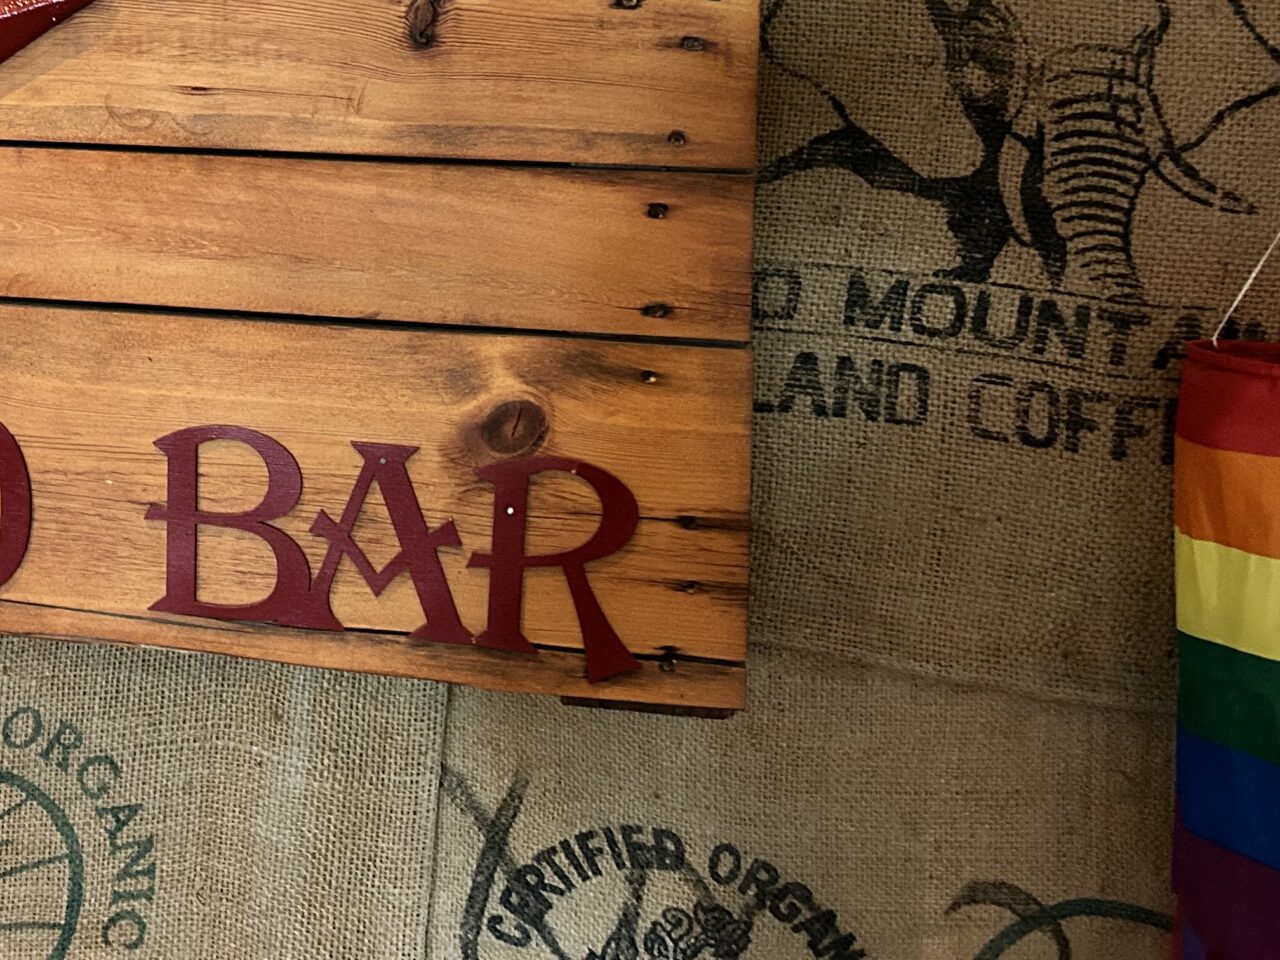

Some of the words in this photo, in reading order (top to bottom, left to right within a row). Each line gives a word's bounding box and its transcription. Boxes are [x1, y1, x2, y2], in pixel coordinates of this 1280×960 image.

[844, 272, 1267, 370] MOUNTA
[145, 424, 641, 684] BAR
[1, 705, 156, 951] ORGANIC
[486, 824, 685, 948] CERTIFIED
